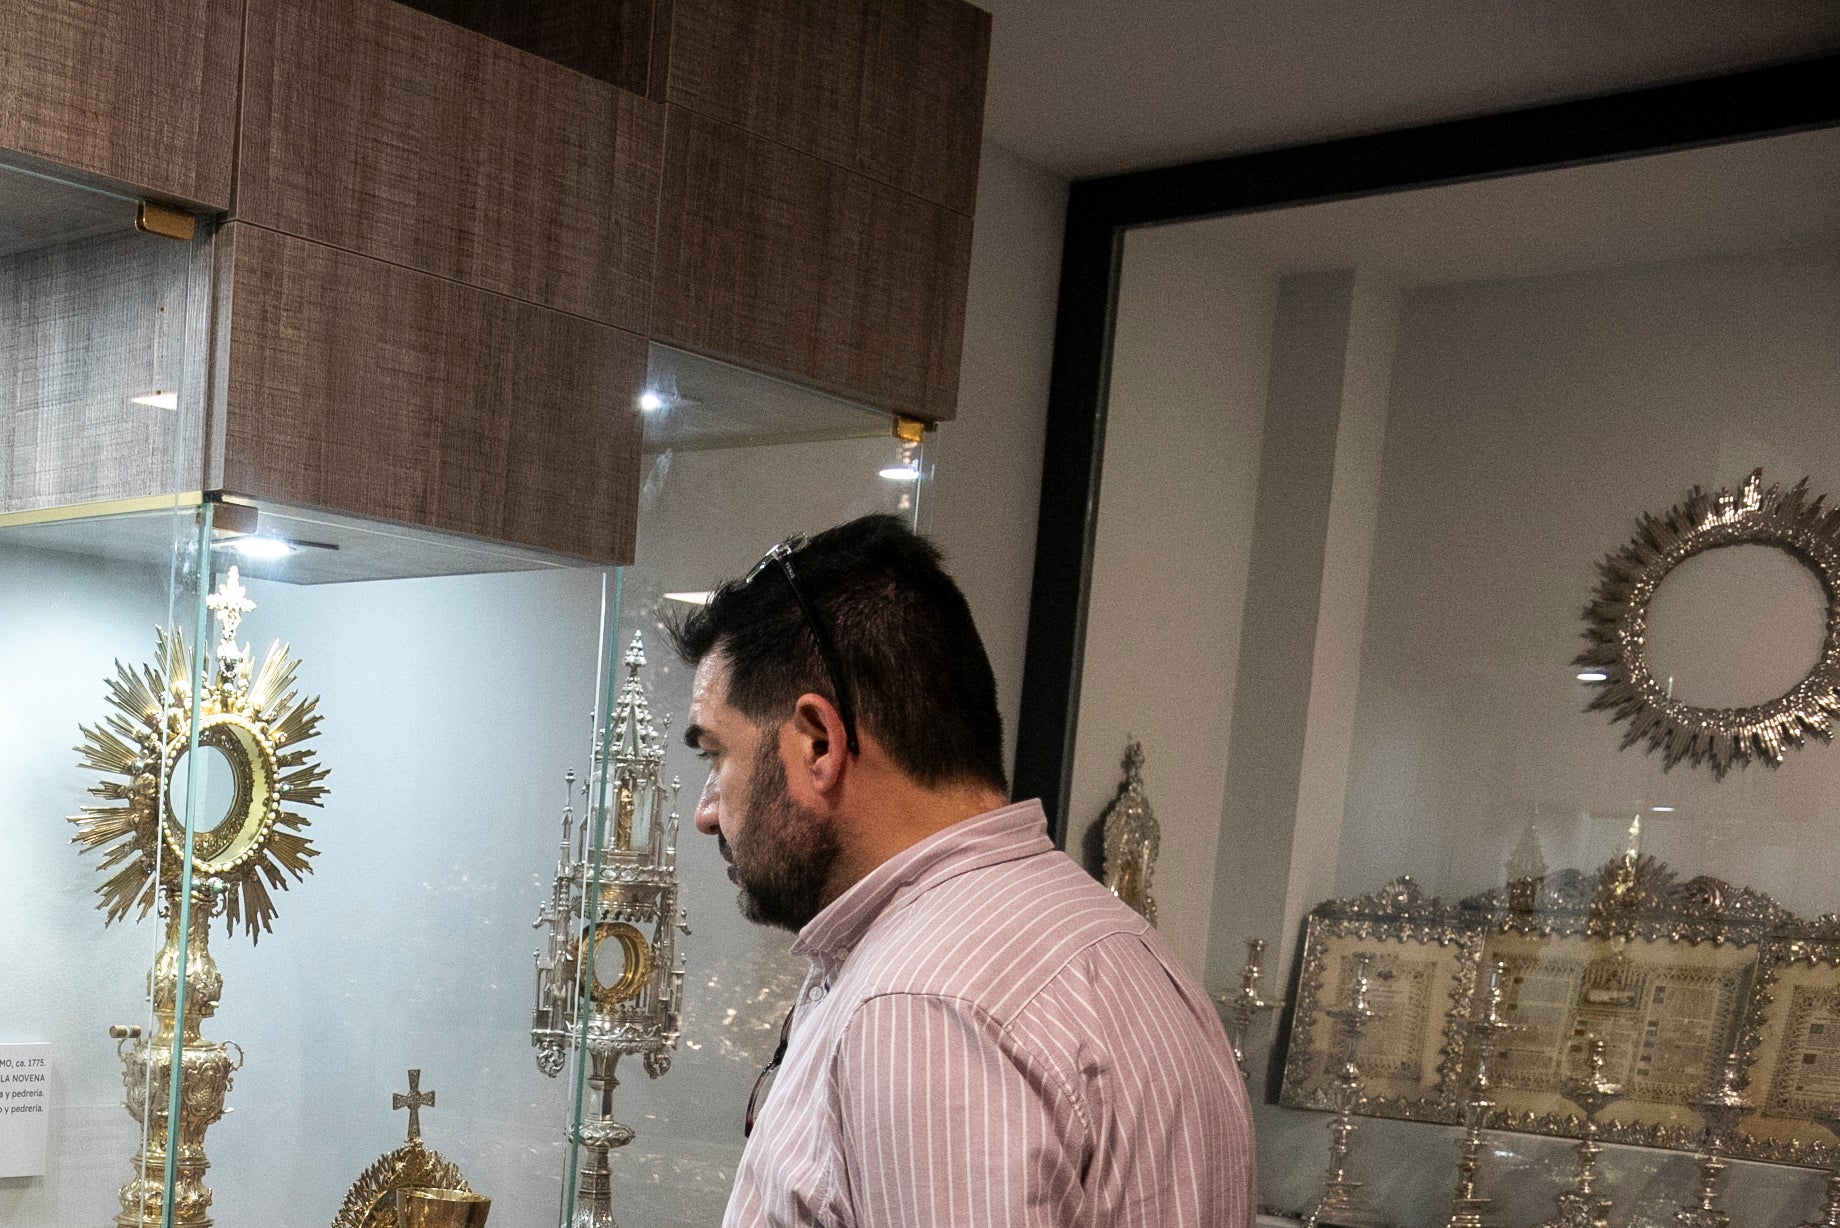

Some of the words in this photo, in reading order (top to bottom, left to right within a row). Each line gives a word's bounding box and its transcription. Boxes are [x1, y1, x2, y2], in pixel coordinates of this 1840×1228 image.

[0, 1074, 11, 1083] LA
[12, 1073, 46, 1083] NOVENA
[5, 1091, 11, 1100] y
[4, 1106, 11, 1115] y
